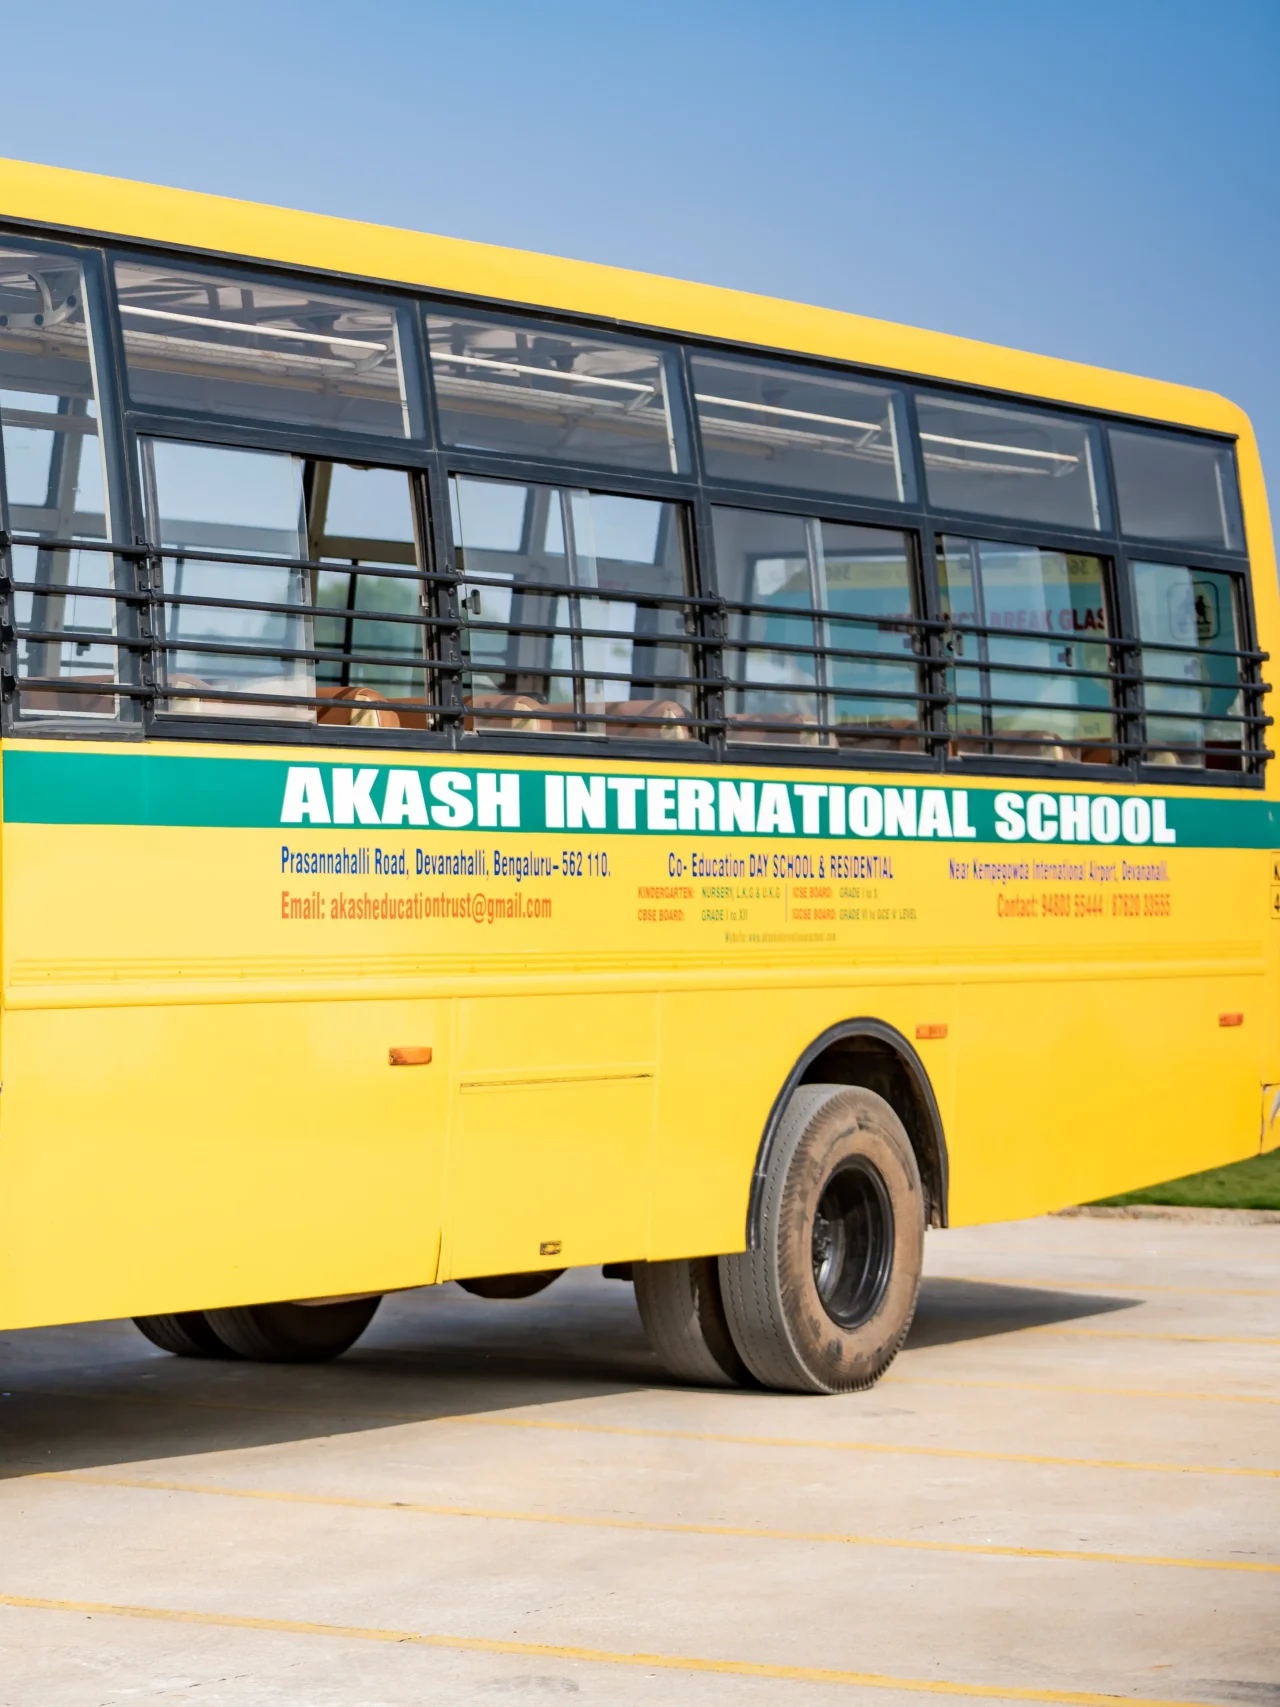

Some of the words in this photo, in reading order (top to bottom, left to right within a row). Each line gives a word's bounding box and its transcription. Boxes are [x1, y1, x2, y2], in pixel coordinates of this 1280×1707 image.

[1059, 607, 1105, 631] GLAS
[280, 766, 520, 828] AKASH
[544, 774, 976, 838] INTERNATIONAL
[994, 791, 1176, 844] SCHOOL
[281, 846, 370, 876] Prasannahalli
[375, 847, 409, 879] Road,
[416, 848, 490, 880] Devanahalli,
[691, 852, 745, 877] Education
[749, 853, 769, 878] DAY
[773, 854, 814, 878] SCHOOL
[818, 855, 825, 878] &
[830, 855, 894, 879] RESIDENTIAL
[949, 858, 970, 881] Near
[1032, 859, 1086, 881] International
[839, 887, 860, 899] GRADE
[281, 891, 325, 920] Email:
[330, 892, 552, 924] akasheducationtrust@gmail.com
[638, 908, 657, 921] CBSE
[701, 909, 724, 921] GRADE
